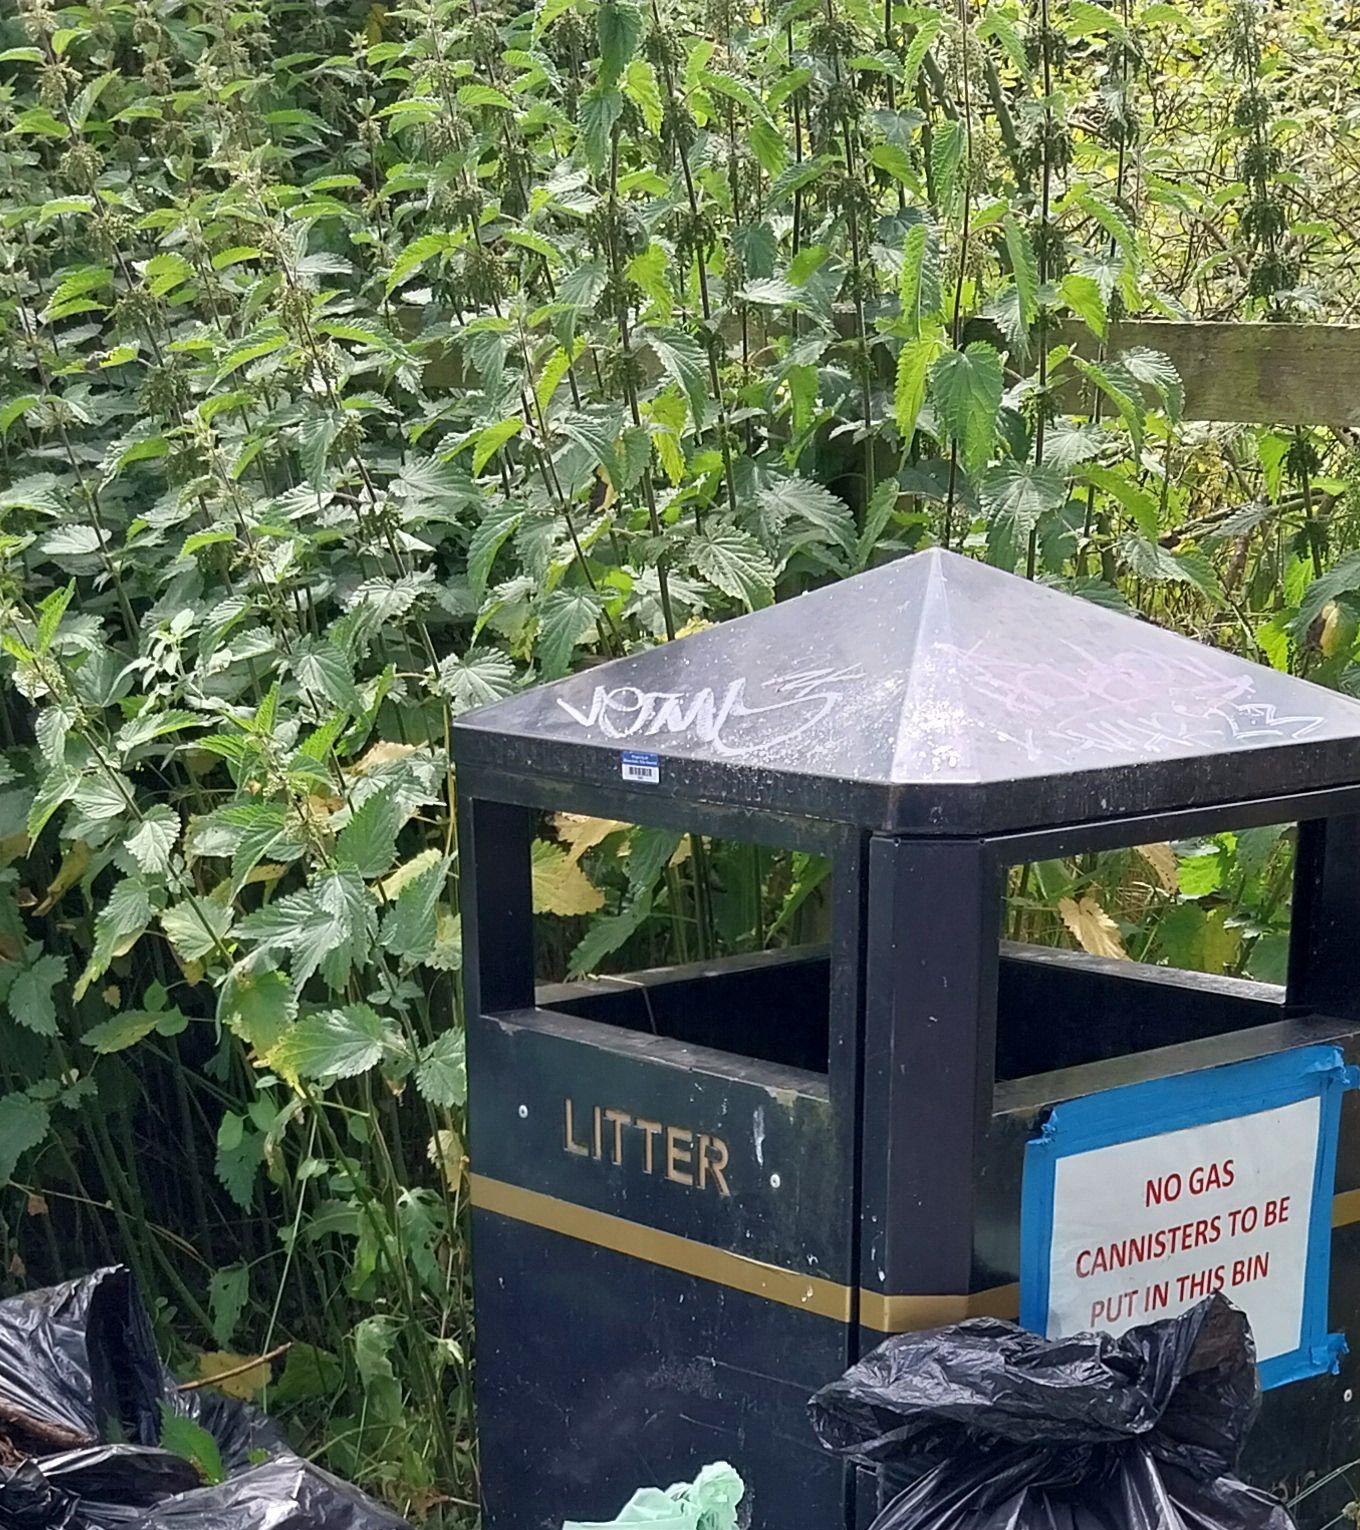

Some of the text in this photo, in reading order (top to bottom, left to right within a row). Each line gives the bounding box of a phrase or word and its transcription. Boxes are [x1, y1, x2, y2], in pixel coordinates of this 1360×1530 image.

[563, 1098, 731, 1197] LITTER
[1145, 1159, 1235, 1207] NO GAS
[1075, 1196, 1291, 1278] CANNISTERS TO BE
[1090, 1251, 1270, 1328] PUT IN THIS BIN
